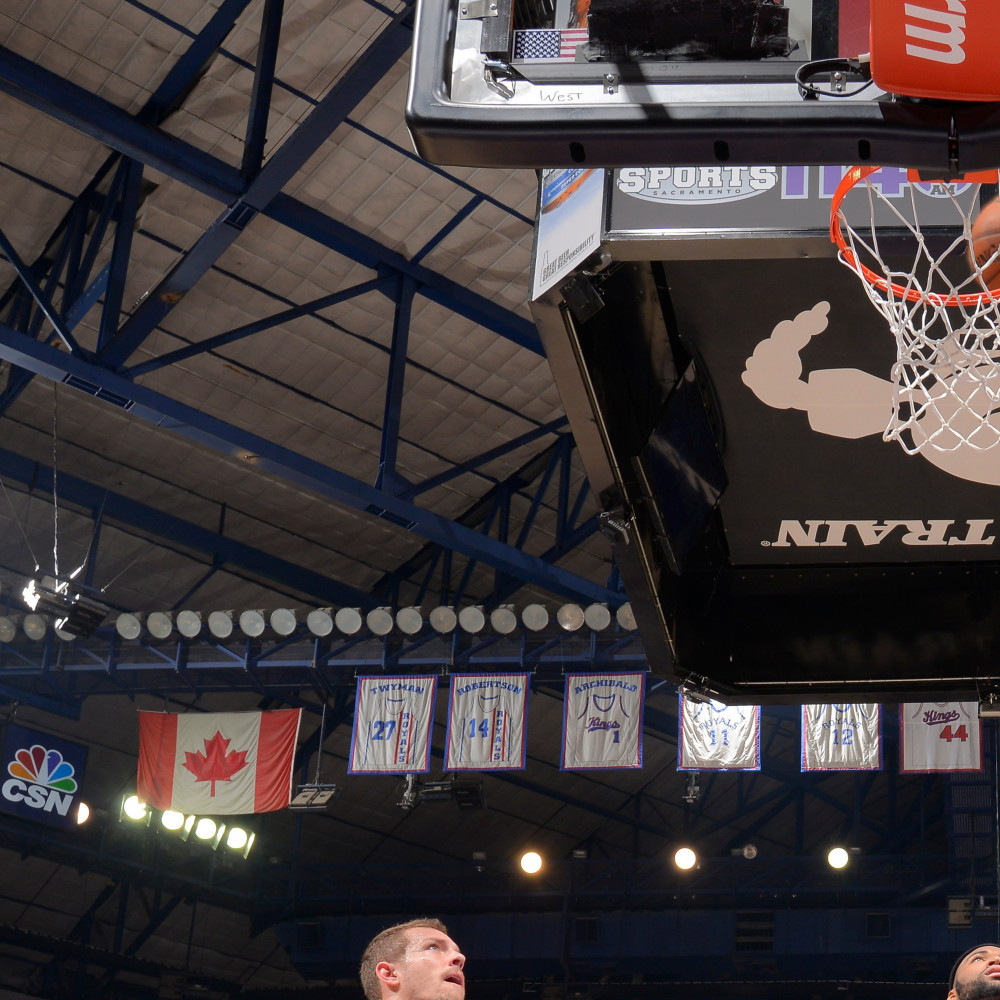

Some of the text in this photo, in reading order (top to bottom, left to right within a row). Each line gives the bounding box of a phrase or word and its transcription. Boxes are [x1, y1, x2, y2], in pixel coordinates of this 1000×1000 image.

[618, 166, 777, 193] SPORTS
[771, 519, 996, 547] TRAIN
[370, 683, 424, 695] TWYMAN
[456, 680, 522, 696] ROBERTSON
[573, 679, 638, 695] ARCHIBALD
[585, 716, 620, 732] Kings
[821, 717, 862, 731] ROYALS
[922, 709, 961, 726] Kings
[372, 720, 396, 740] 27
[468, 718, 490, 738] 14
[612, 730, 620, 743] 1
[939, 725, 969, 742] 44
[710, 729, 728, 746] 11
[832, 729, 854, 745] 12
[1, 778, 73, 817] CSN
